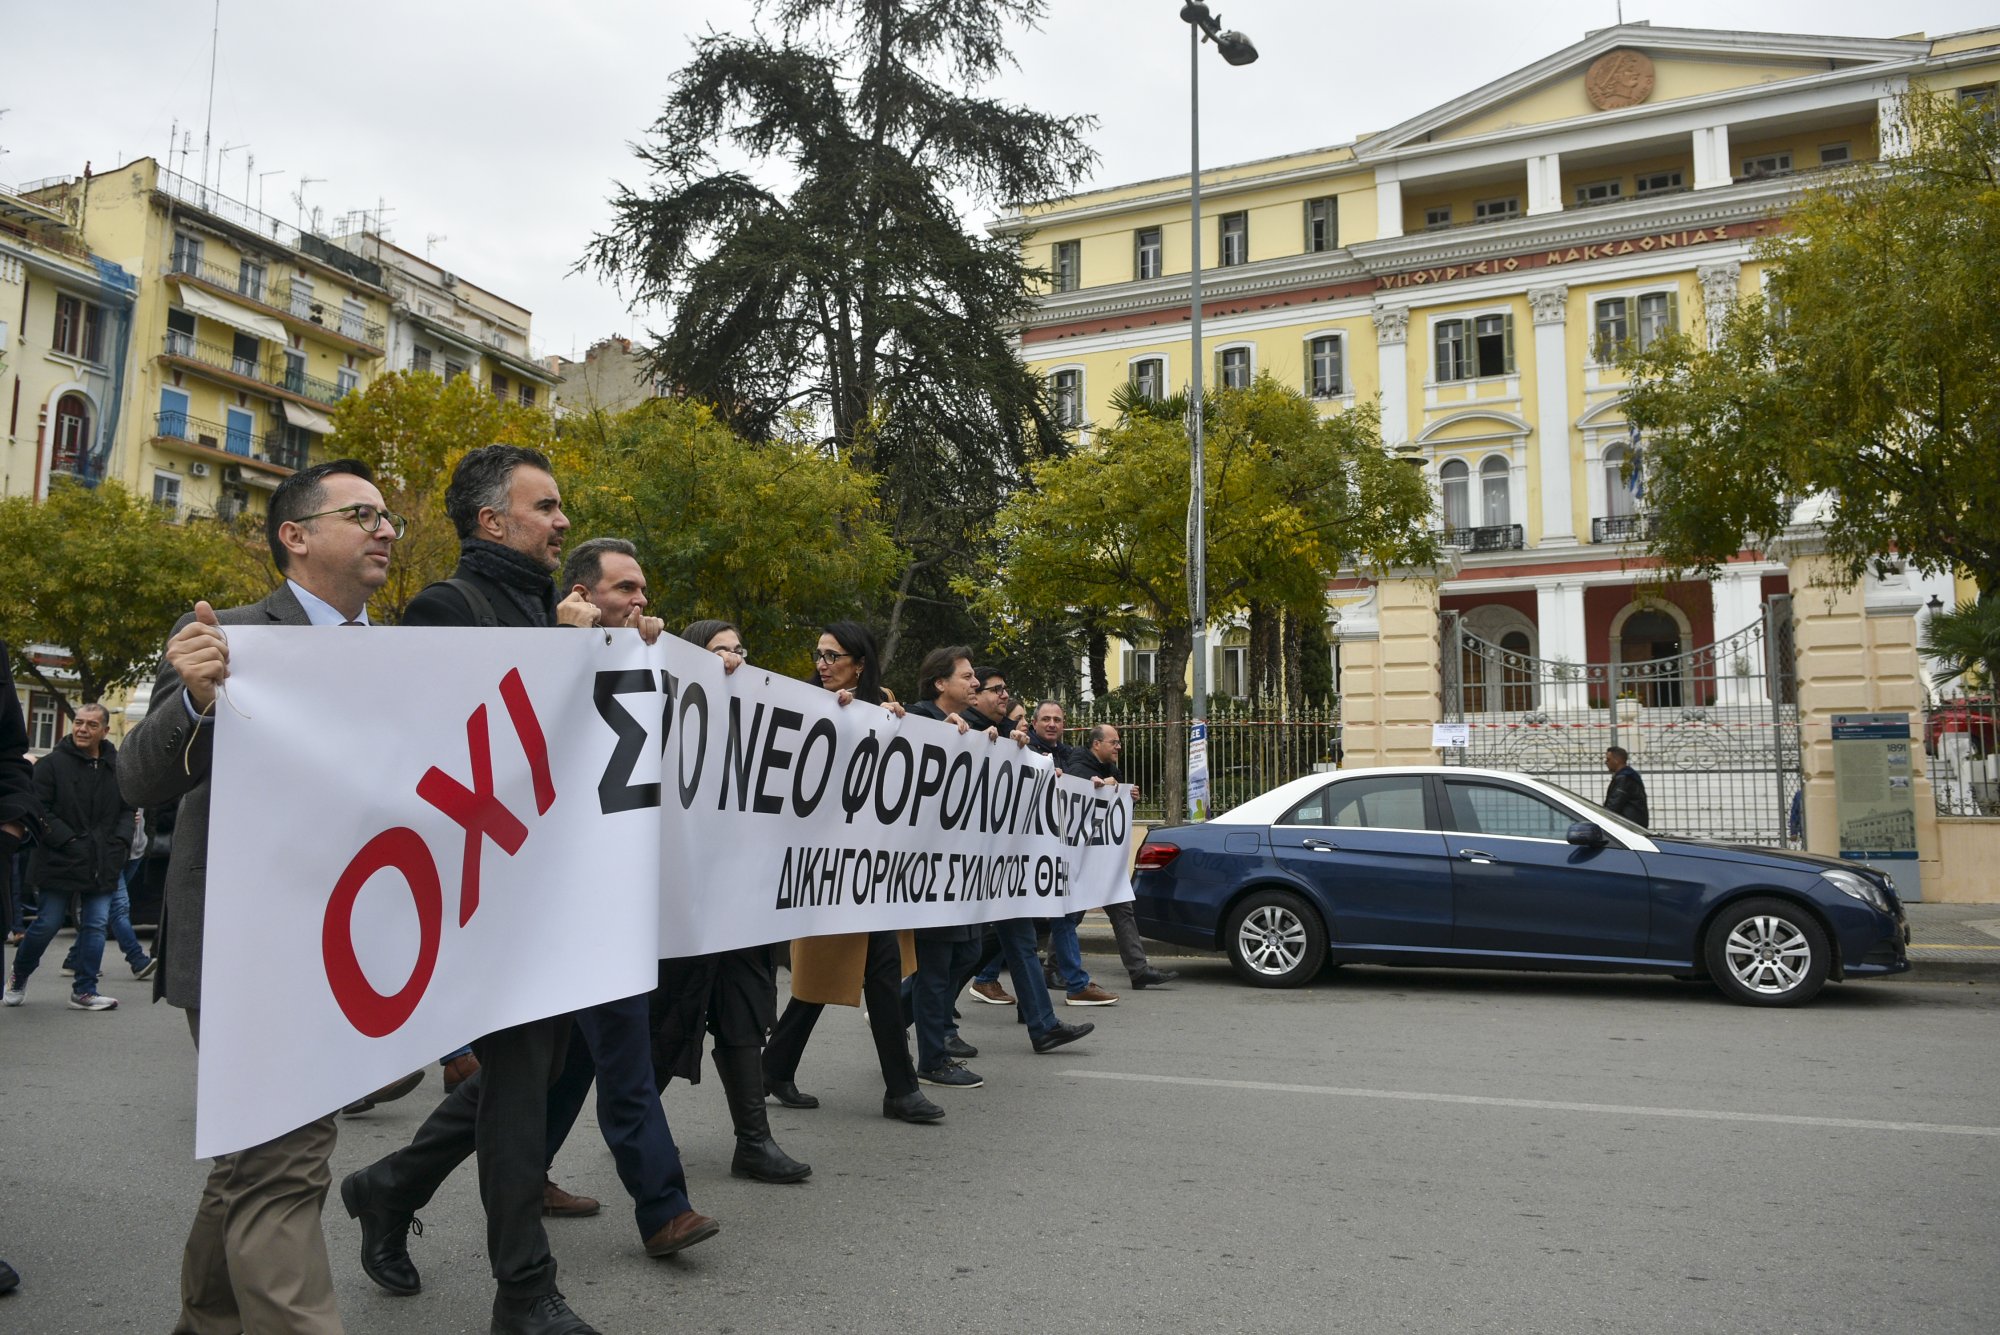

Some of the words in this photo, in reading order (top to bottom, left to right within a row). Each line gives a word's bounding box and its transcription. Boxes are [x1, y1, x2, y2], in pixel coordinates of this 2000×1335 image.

[1382, 257, 1519, 289] ΥΠΟΥΡΓΕΙΟ
[1546, 226, 1728, 266] ΜΑΚΕΔΟΝΙΑΣ
[1887, 744, 1907, 752] 1891
[322, 667, 556, 1038] ΟΧΙ
[717, 696, 838, 818] ΝΕΟ
[776, 846, 942, 910] ΔΙΚΗΓΟΡΙΚΟΣ
